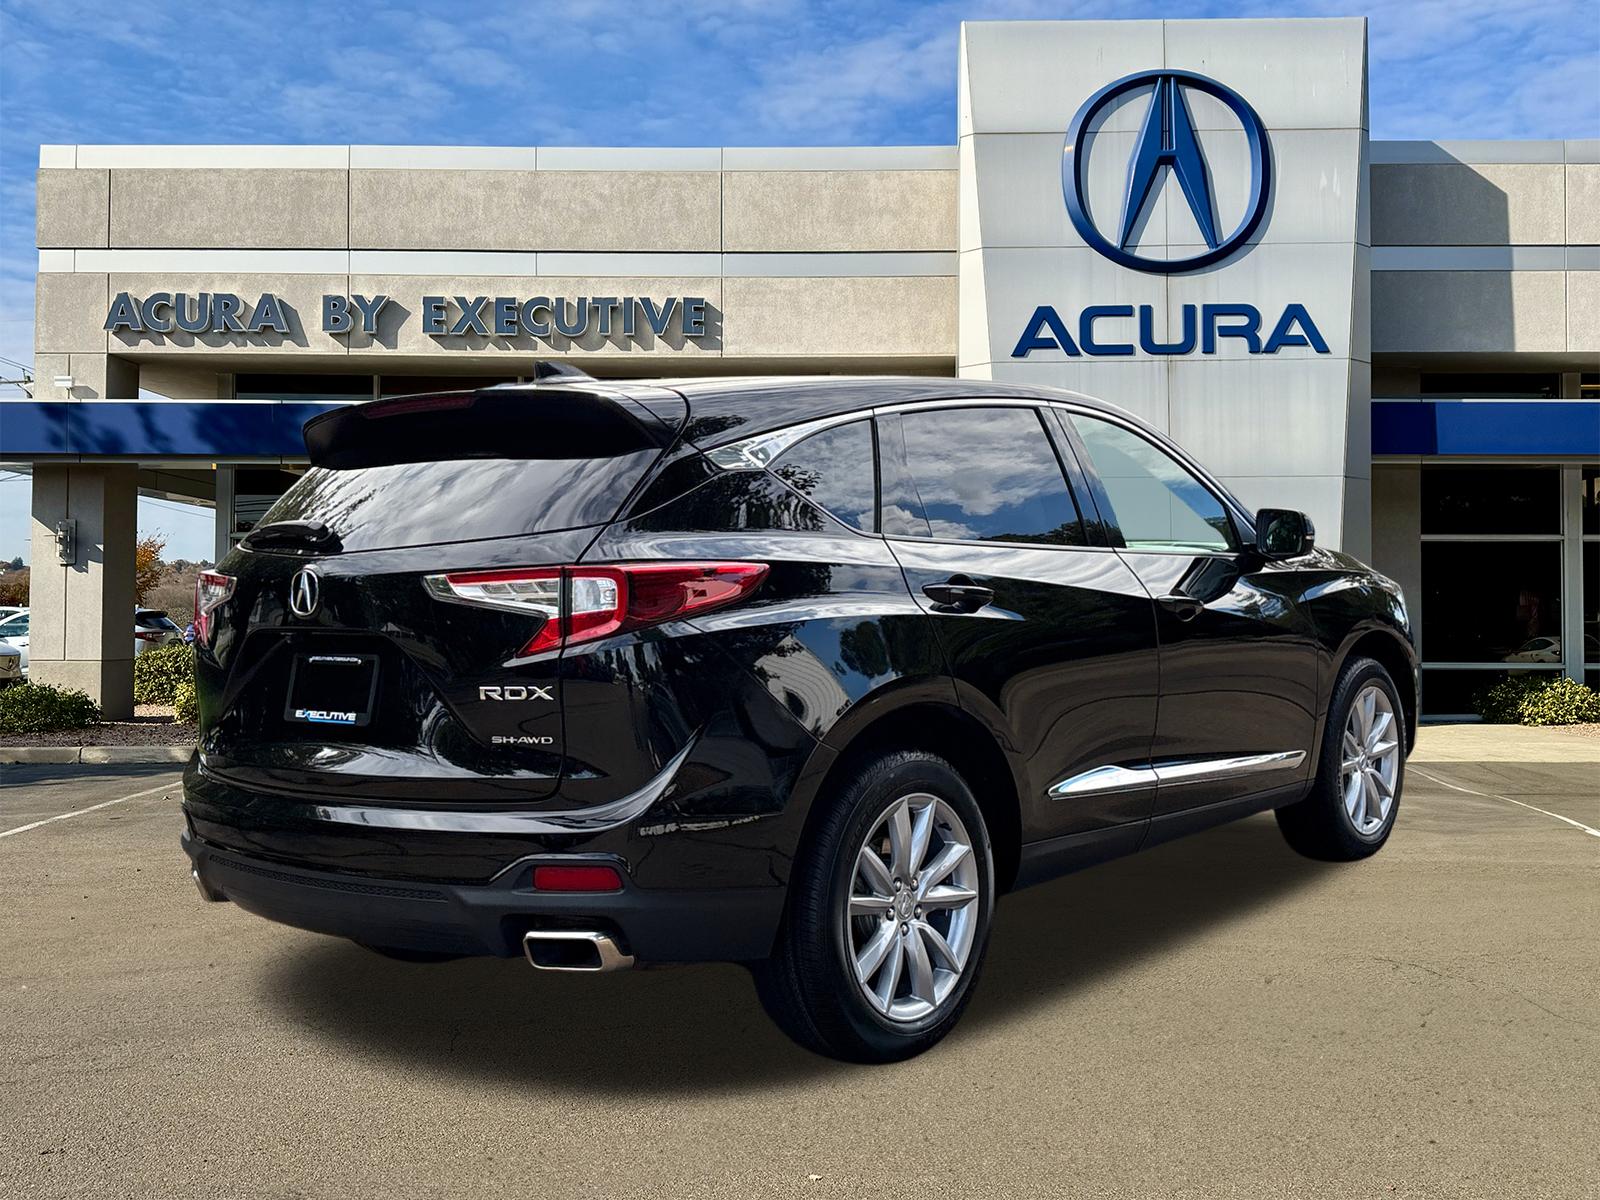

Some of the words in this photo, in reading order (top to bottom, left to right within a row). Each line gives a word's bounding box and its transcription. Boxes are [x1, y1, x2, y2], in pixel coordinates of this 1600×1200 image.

[103, 291, 290, 333] ACURA
[322, 294, 391, 334] BY
[422, 296, 706, 336] EXECUTIVE
[1010, 303, 1332, 358] ACURA
[479, 686, 554, 700] RDX
[295, 709, 356, 721] EXECUTIVE
[491, 736, 553, 744] SH-AWD
